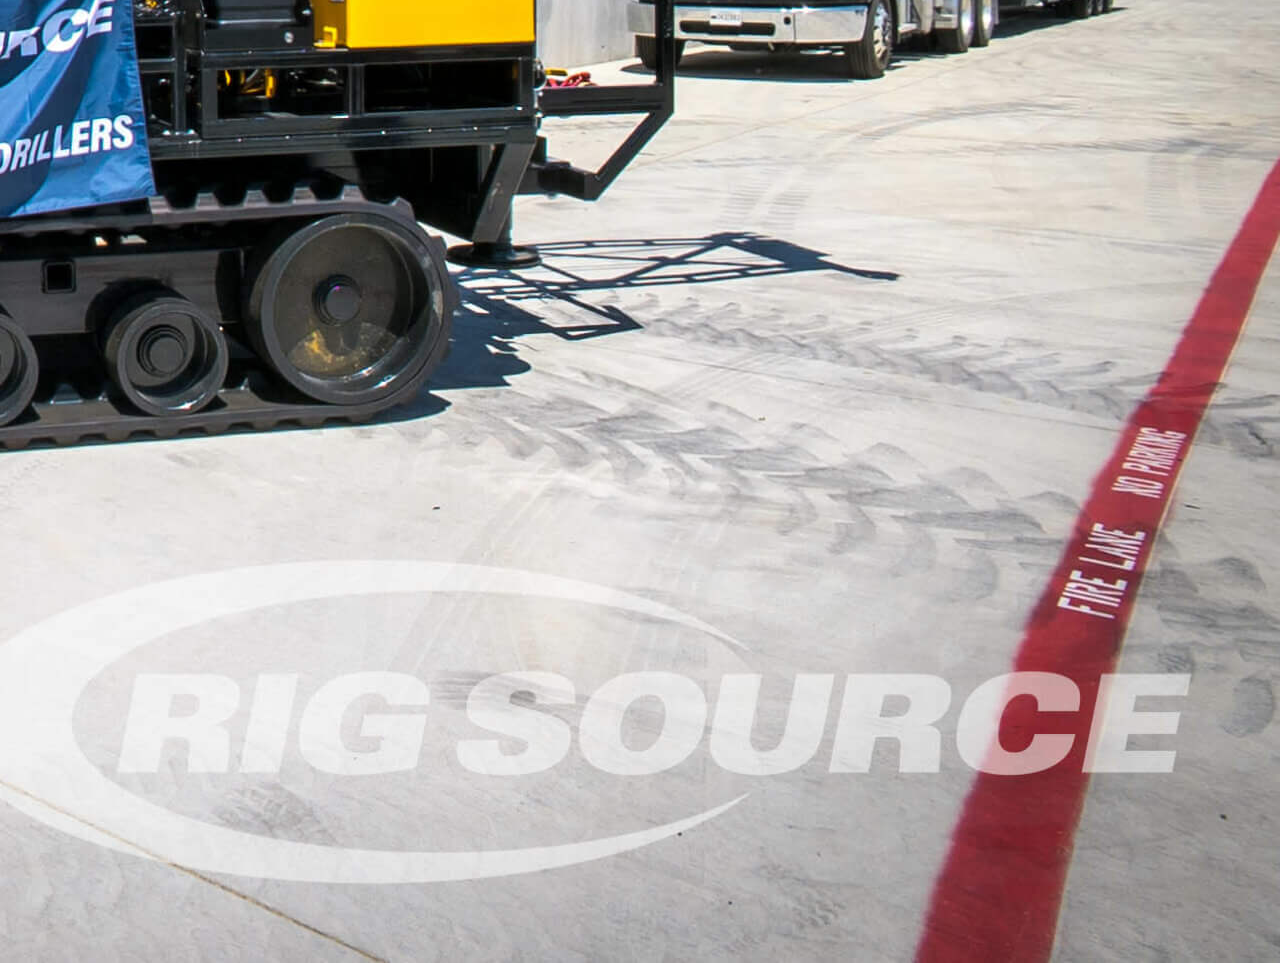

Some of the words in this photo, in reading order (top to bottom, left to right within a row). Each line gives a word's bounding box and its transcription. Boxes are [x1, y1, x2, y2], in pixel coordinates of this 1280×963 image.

[1122, 427, 1187, 476] PARKING
[1111, 476, 1164, 498] NO
[1078, 523, 1146, 570] LANE
[1057, 570, 1128, 619] FIRE
